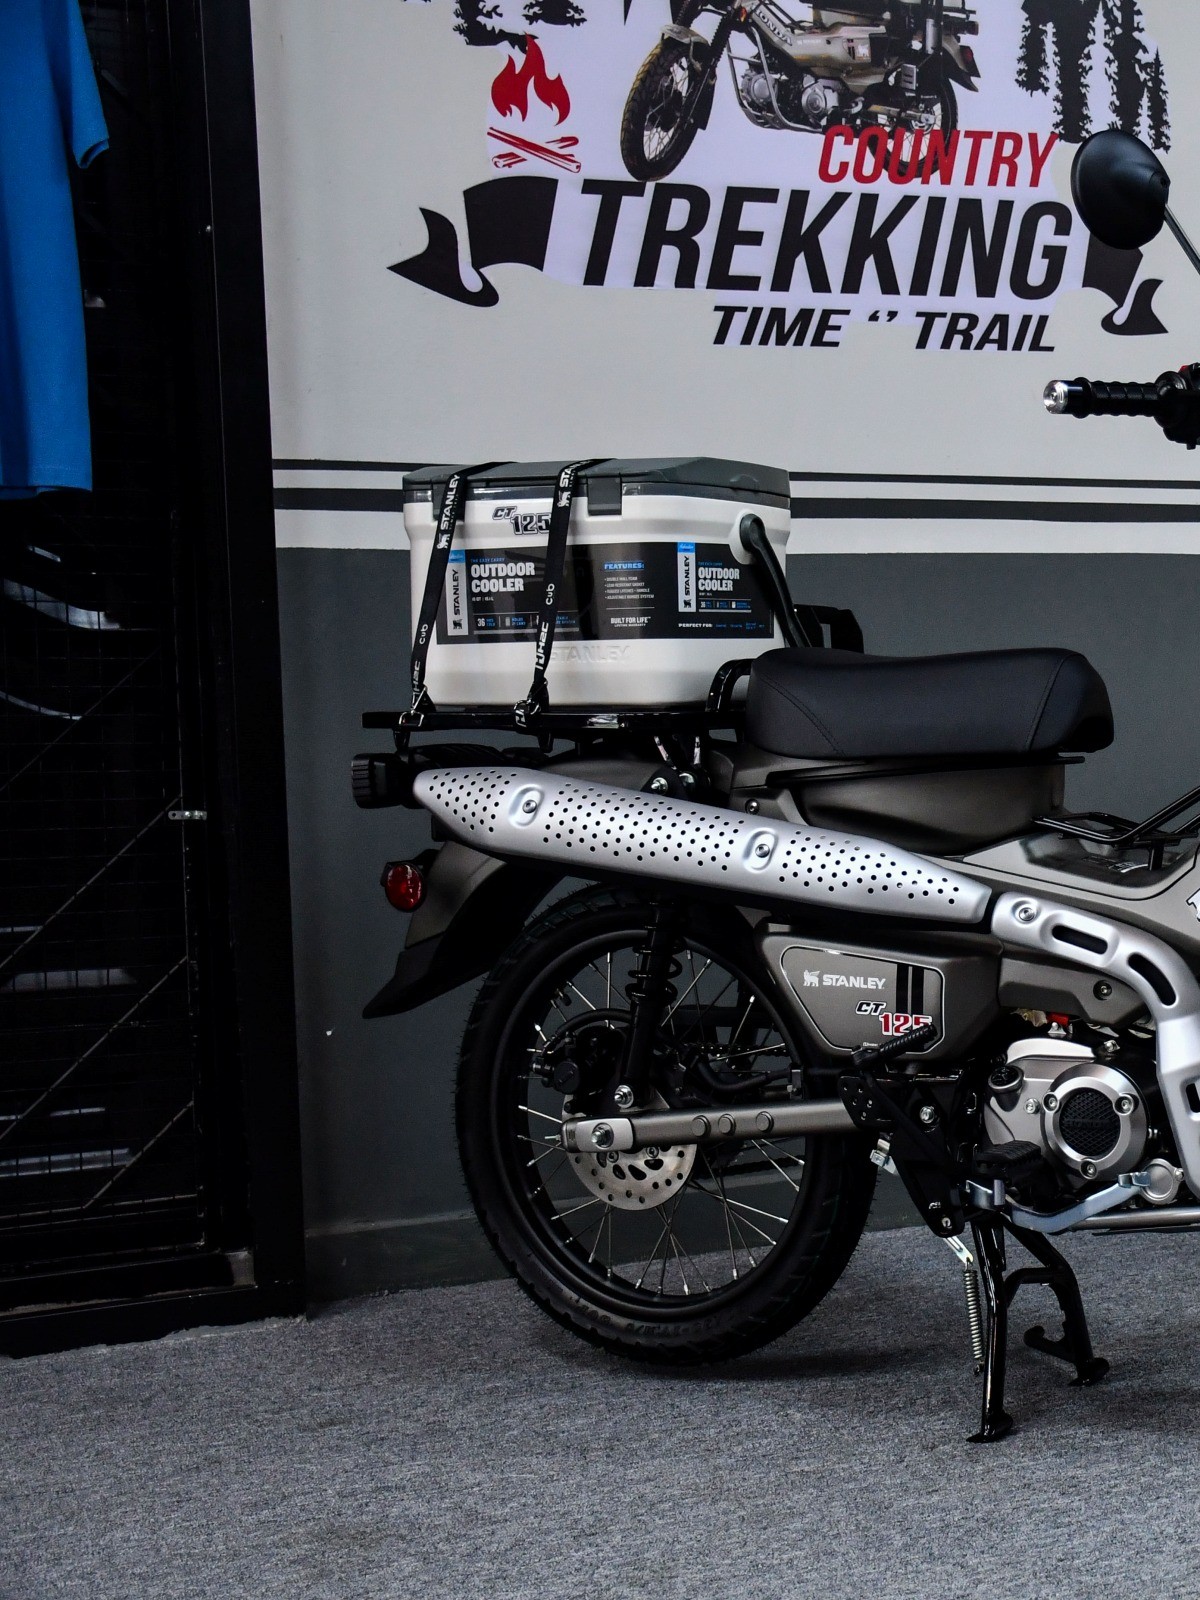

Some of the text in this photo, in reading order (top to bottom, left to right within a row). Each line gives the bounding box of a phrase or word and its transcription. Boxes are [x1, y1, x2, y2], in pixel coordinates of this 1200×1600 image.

[818, 124, 1059, 187] COUNTRY
[580, 179, 1074, 299] TREKKING
[713, 306, 1056, 352] TIME TRAIL
[441, 475, 460, 530] STANLEY
[493, 506, 517, 520] CT
[510, 513, 551, 535] 125
[471, 562, 535, 578] OUTDOOR
[698, 567, 740, 580] OUTDOOR
[453, 569, 461, 616] STANLEY
[472, 578, 524, 593] COOLER
[698, 579, 733, 591] COOLER
[822, 973, 886, 990] STANLEY
[856, 1000, 886, 1016] CT
